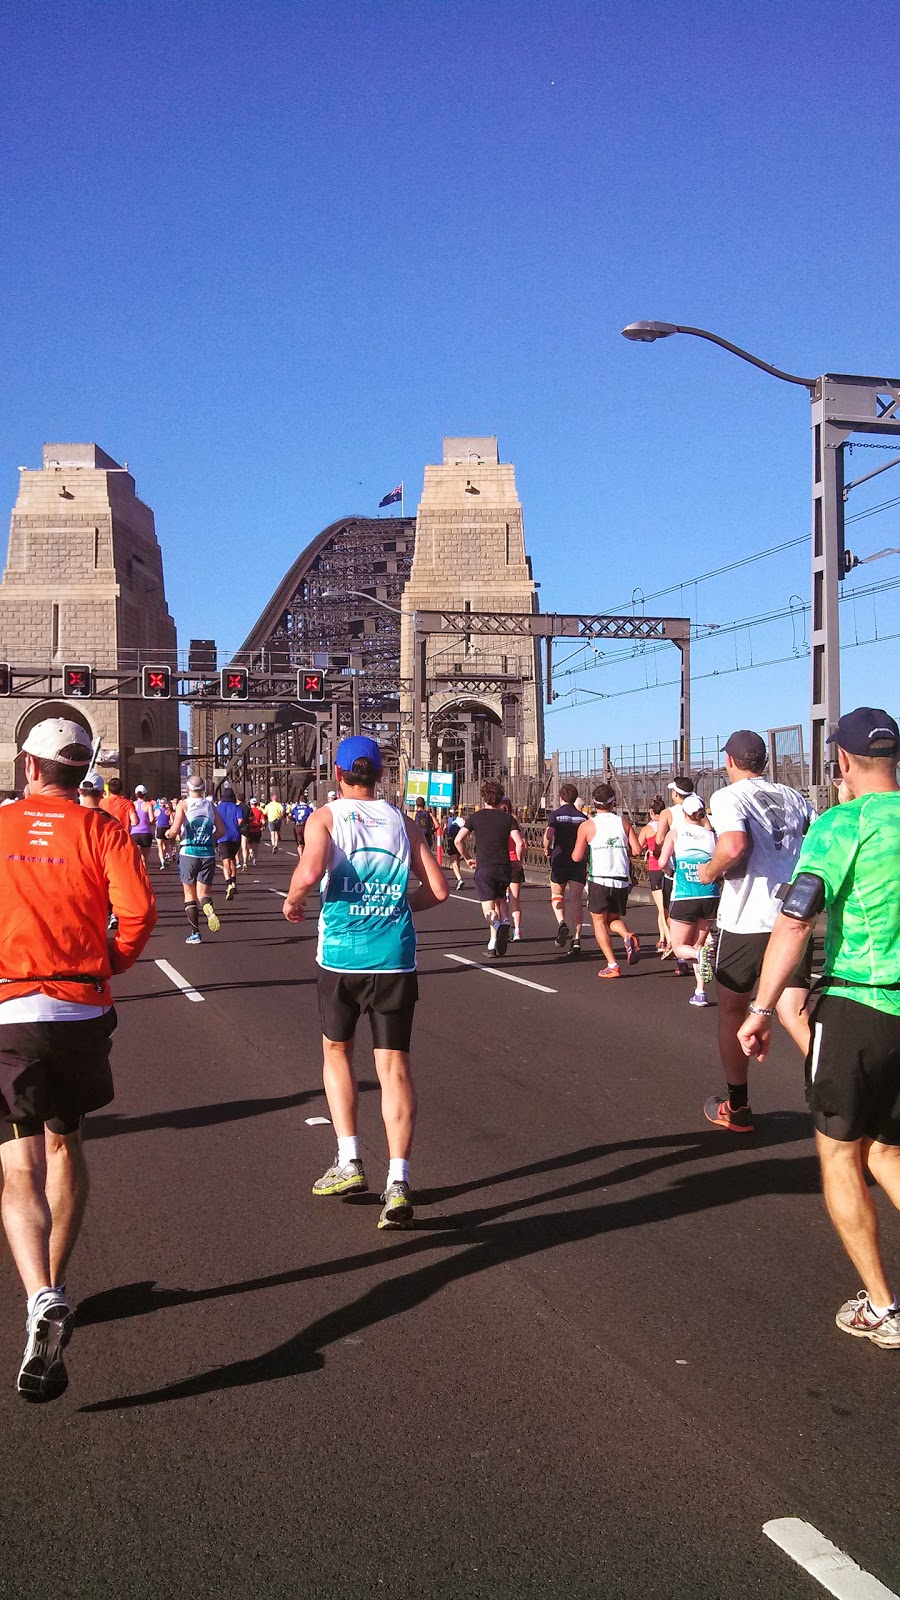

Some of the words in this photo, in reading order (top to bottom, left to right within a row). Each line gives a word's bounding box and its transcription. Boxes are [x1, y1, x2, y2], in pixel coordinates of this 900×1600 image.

[72, 688, 82, 696] 4
[415, 781, 420, 794] 1
[437, 783, 444, 796] 1
[297, 809, 305, 821] 7
[680, 861, 700, 869] Don'
[342, 876, 403, 901] Loving
[362, 893, 387, 905] every
[348, 902, 401, 917] minute
